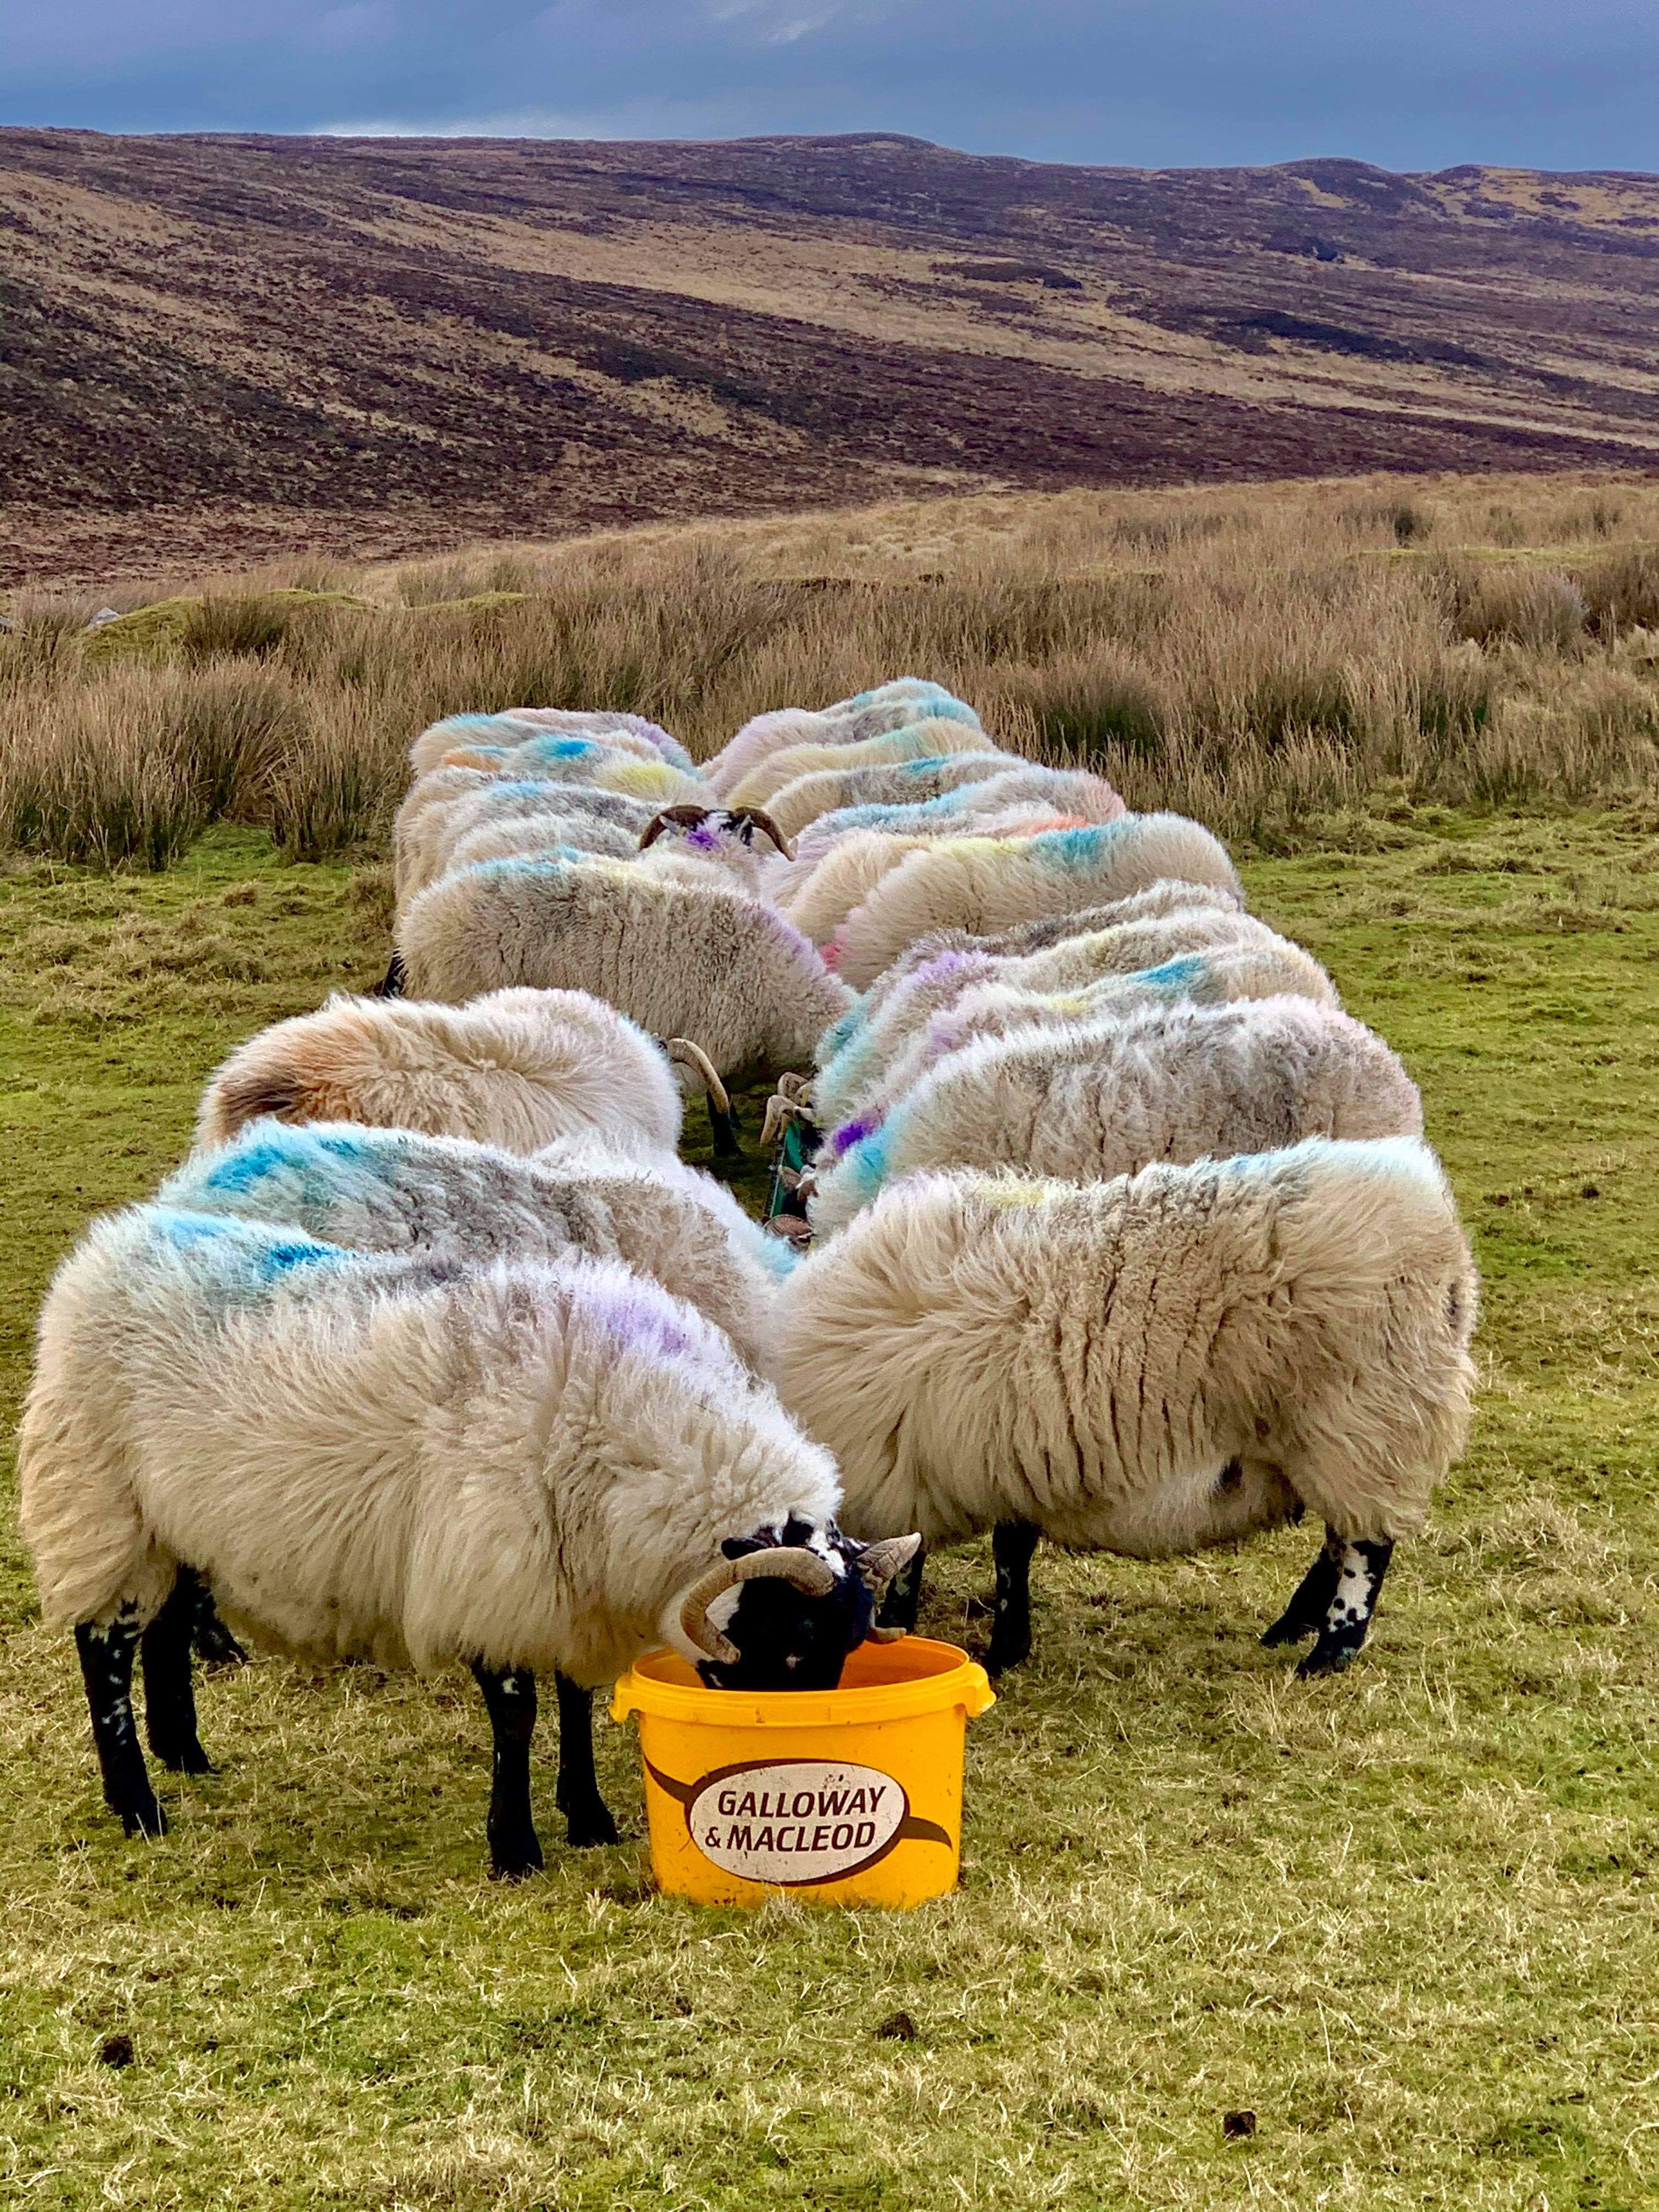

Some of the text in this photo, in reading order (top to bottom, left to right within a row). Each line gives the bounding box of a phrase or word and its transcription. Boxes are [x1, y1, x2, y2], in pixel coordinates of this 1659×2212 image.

[718, 1786, 887, 1818] GALLOWAY
[705, 1821, 876, 1852] & MACLEOD
